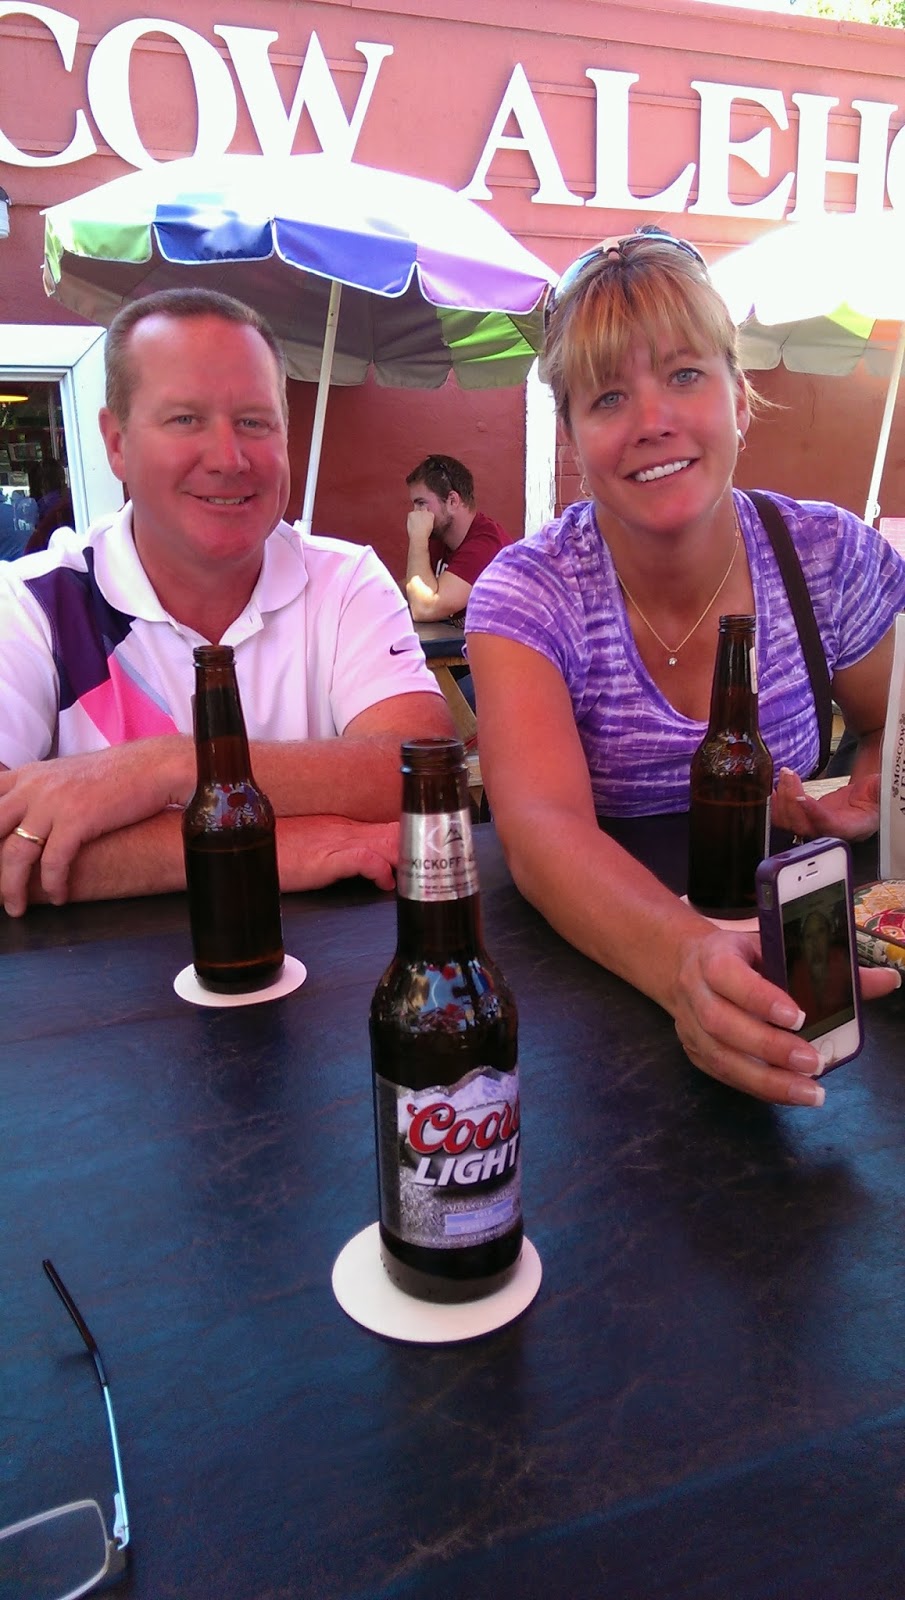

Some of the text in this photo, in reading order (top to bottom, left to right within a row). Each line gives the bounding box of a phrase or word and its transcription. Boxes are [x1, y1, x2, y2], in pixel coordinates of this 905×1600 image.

[0, 1, 905, 221] COW ALEH
[414, 1131, 519, 1186] LIGHT
